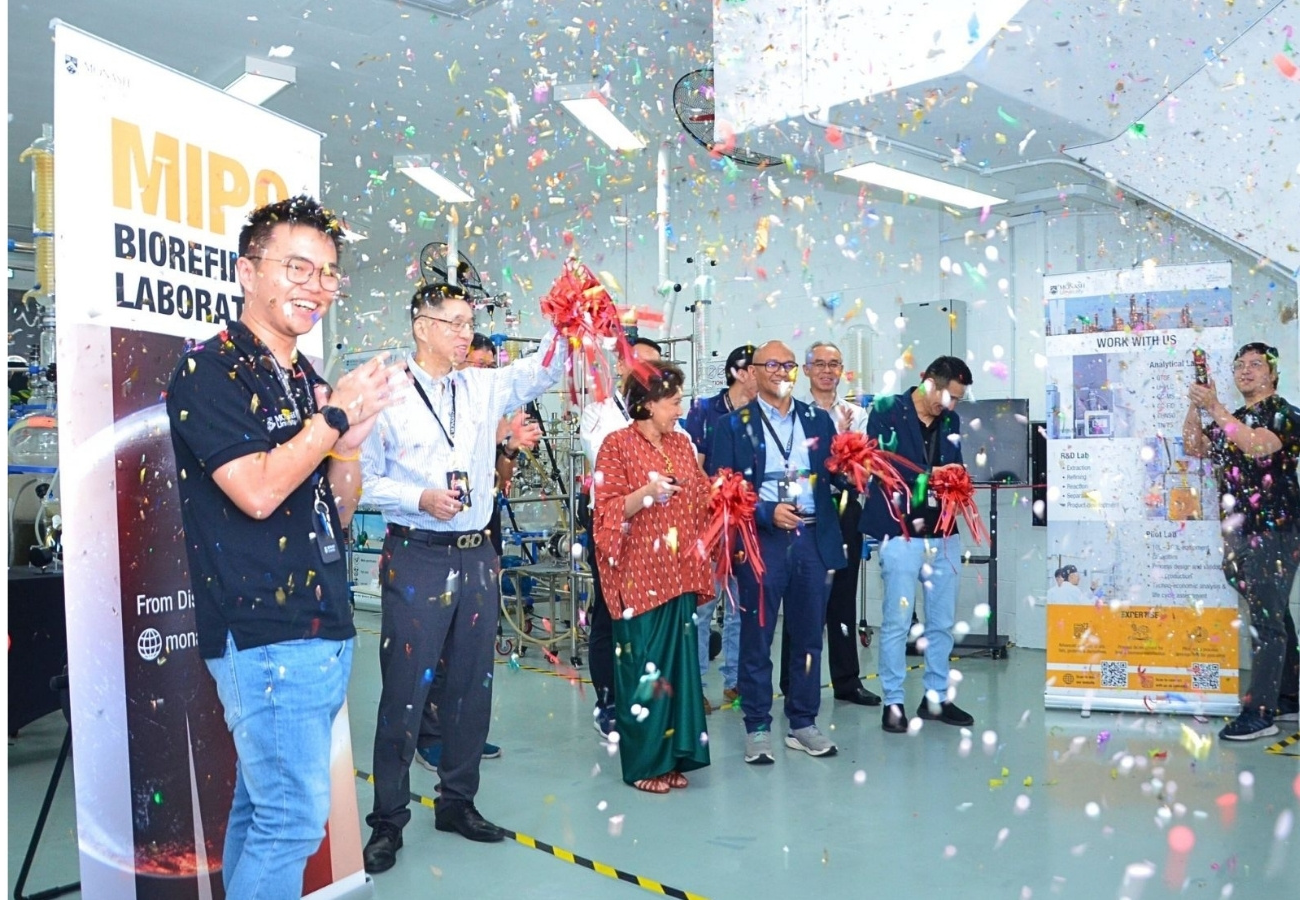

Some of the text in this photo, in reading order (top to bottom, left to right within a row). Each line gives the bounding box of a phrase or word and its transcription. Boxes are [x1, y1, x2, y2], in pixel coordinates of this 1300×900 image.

[114, 222, 239, 282] BIOREFIN
[116, 272, 245, 324] LABORAT
[1096, 334, 1177, 348] WORK WITH US
[1150, 360, 1184, 369] Analytical
[136, 594, 173, 616] From
